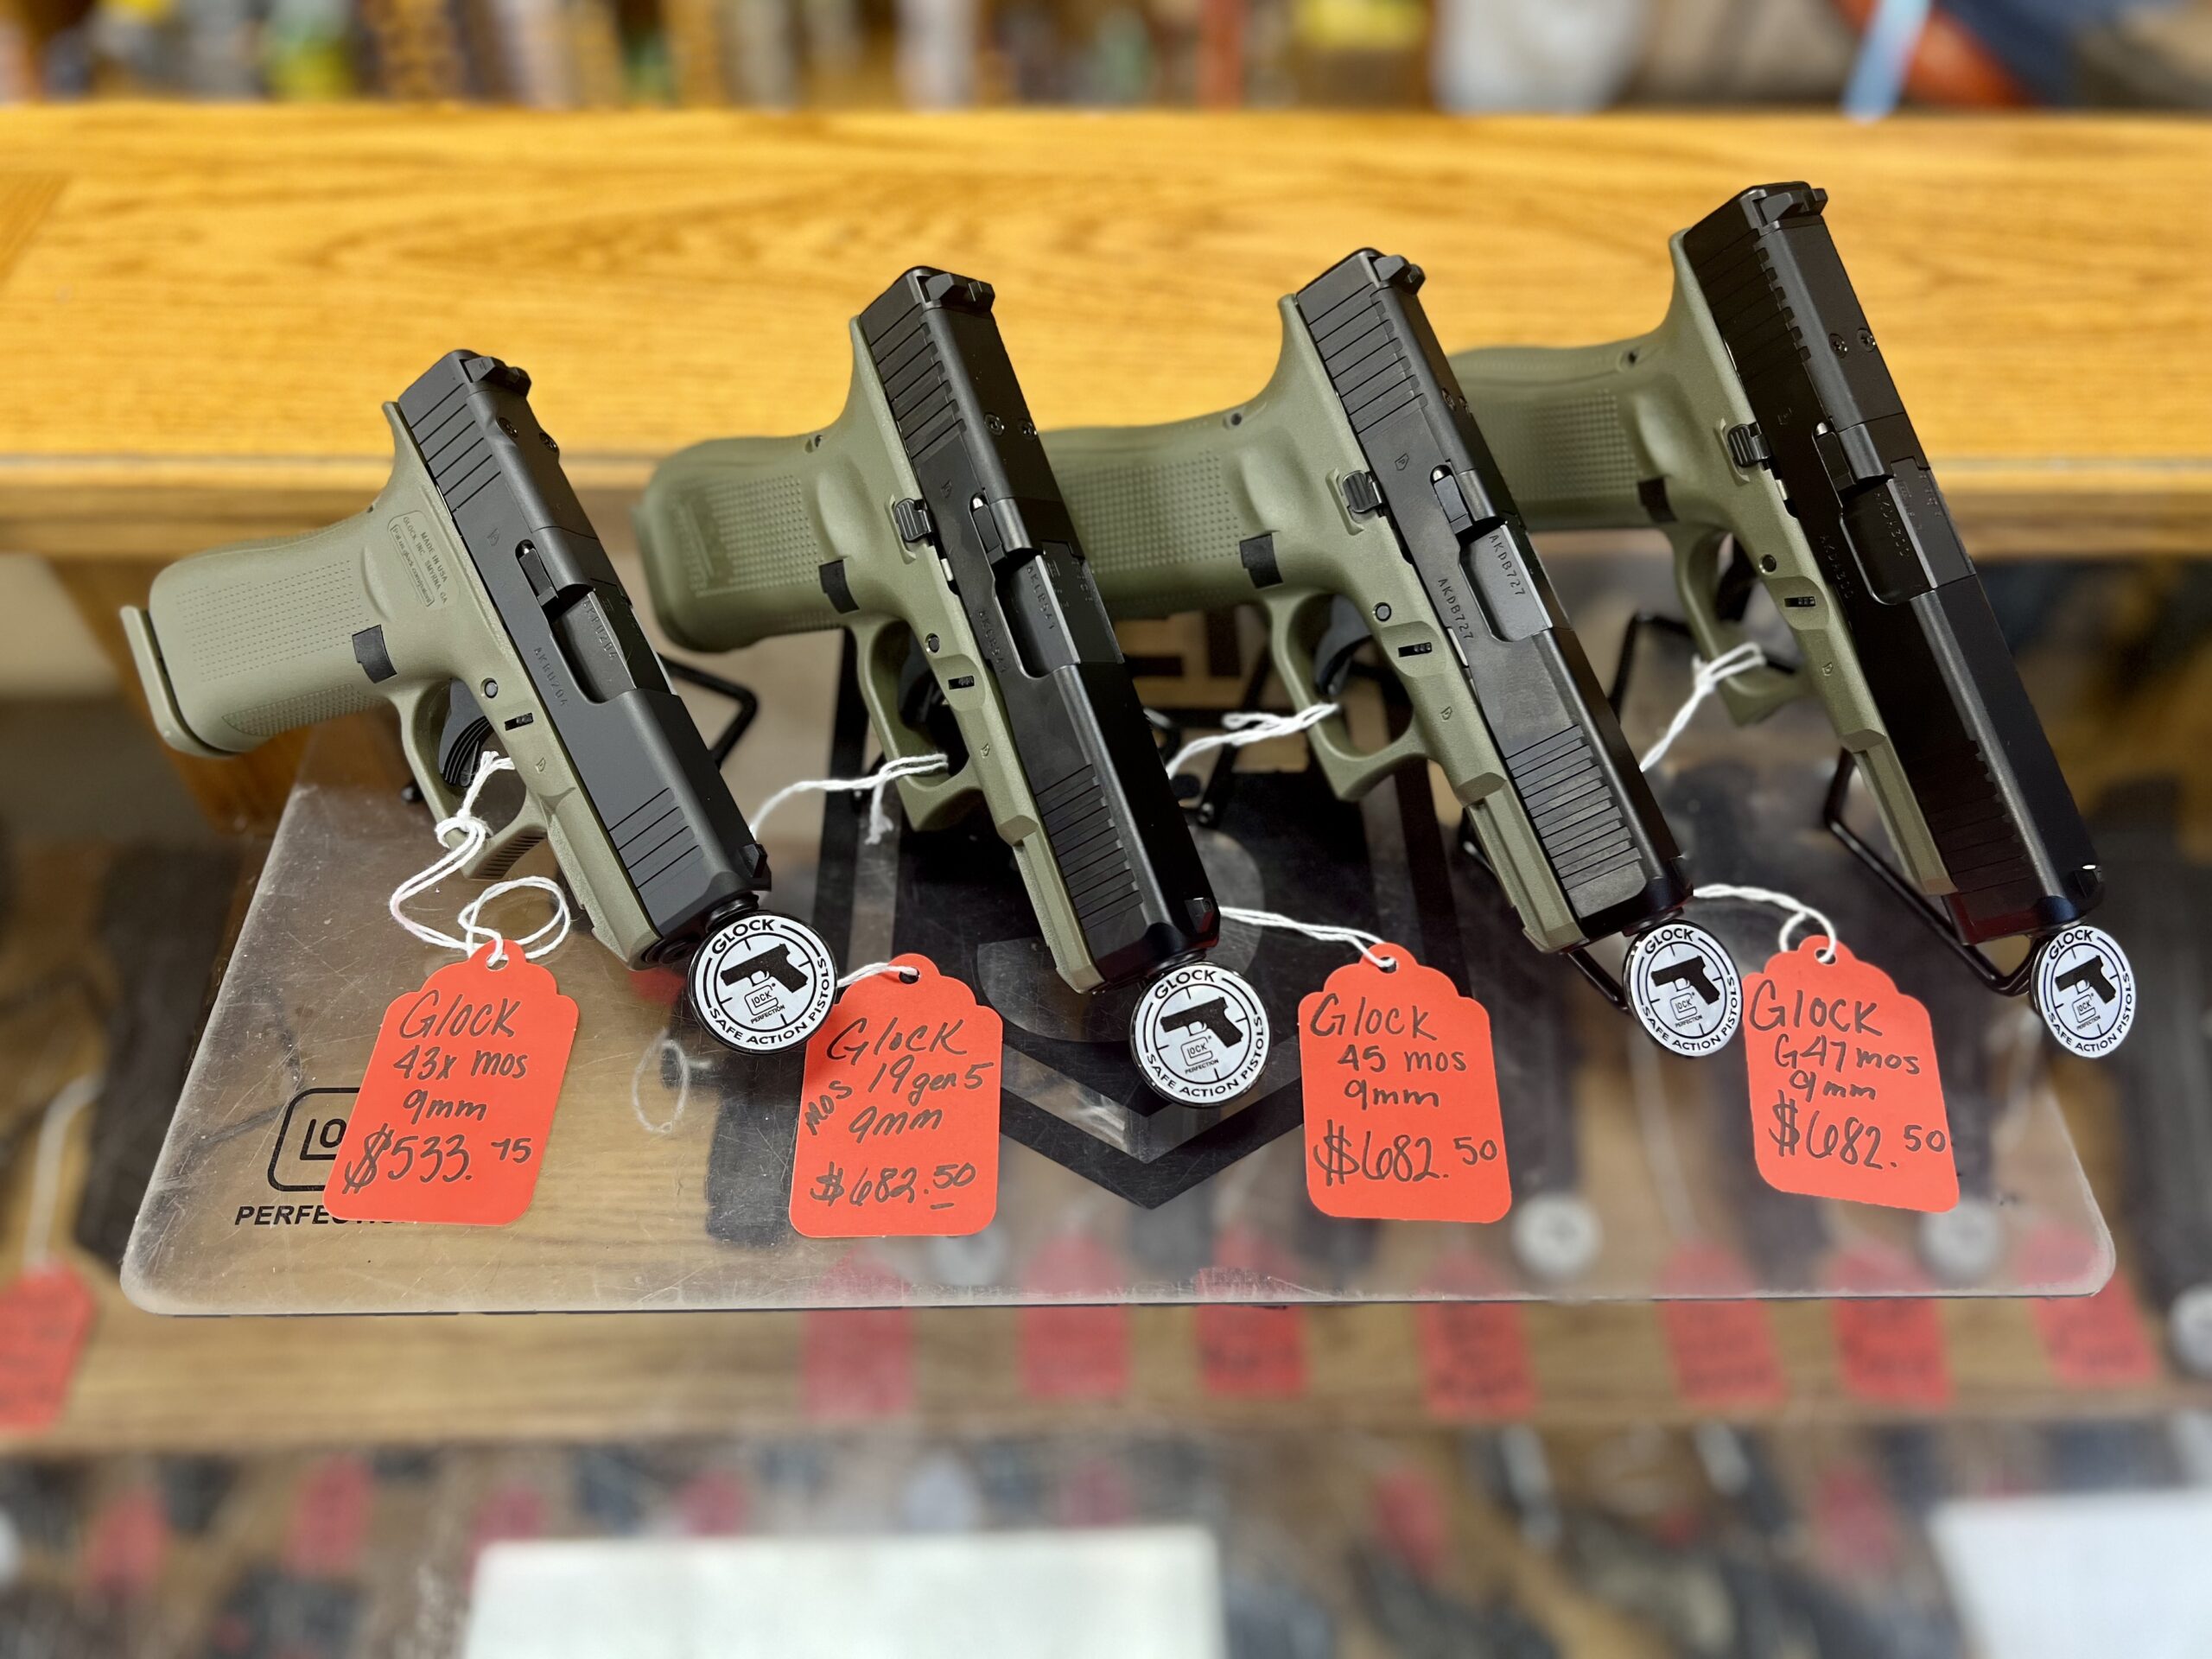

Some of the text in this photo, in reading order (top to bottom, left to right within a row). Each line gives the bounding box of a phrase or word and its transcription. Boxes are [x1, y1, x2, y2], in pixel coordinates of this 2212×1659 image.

[404, 517, 416, 540] GLOCK
[421, 531, 448, 582] MADE IN USA
[1489, 535, 1525, 596] AKDB727
[1438, 578, 1474, 639] AKDB727
[711, 918, 775, 955] GLOCK
[1644, 928, 1694, 954] GLOCK
[2049, 930, 2094, 960] GLOCK
[710, 957, 830, 1046] SAFE ACTION PISTOLS
[1154, 969, 1217, 1000] GLOCK
[750, 1004, 785, 1025] PERFECTION
[1643, 976, 1738, 1051] SAFE ACTION PISTOLS
[2048, 972, 2133, 1052] SAFE ACTION PISTOLS
[393, 1044, 457, 1081] 43x
[1147, 1015, 1264, 1097] SAFE ACTION PISTOLS
[1185, 1058, 1219, 1075] PERFECTION
[1337, 1044, 1386, 1073] 45
[1344, 1078, 1439, 1111] 9mm
[1789, 1069, 1877, 1103] 9mm
[403, 1089, 486, 1124] 9mm
[849, 1105, 943, 1144] 9mm
